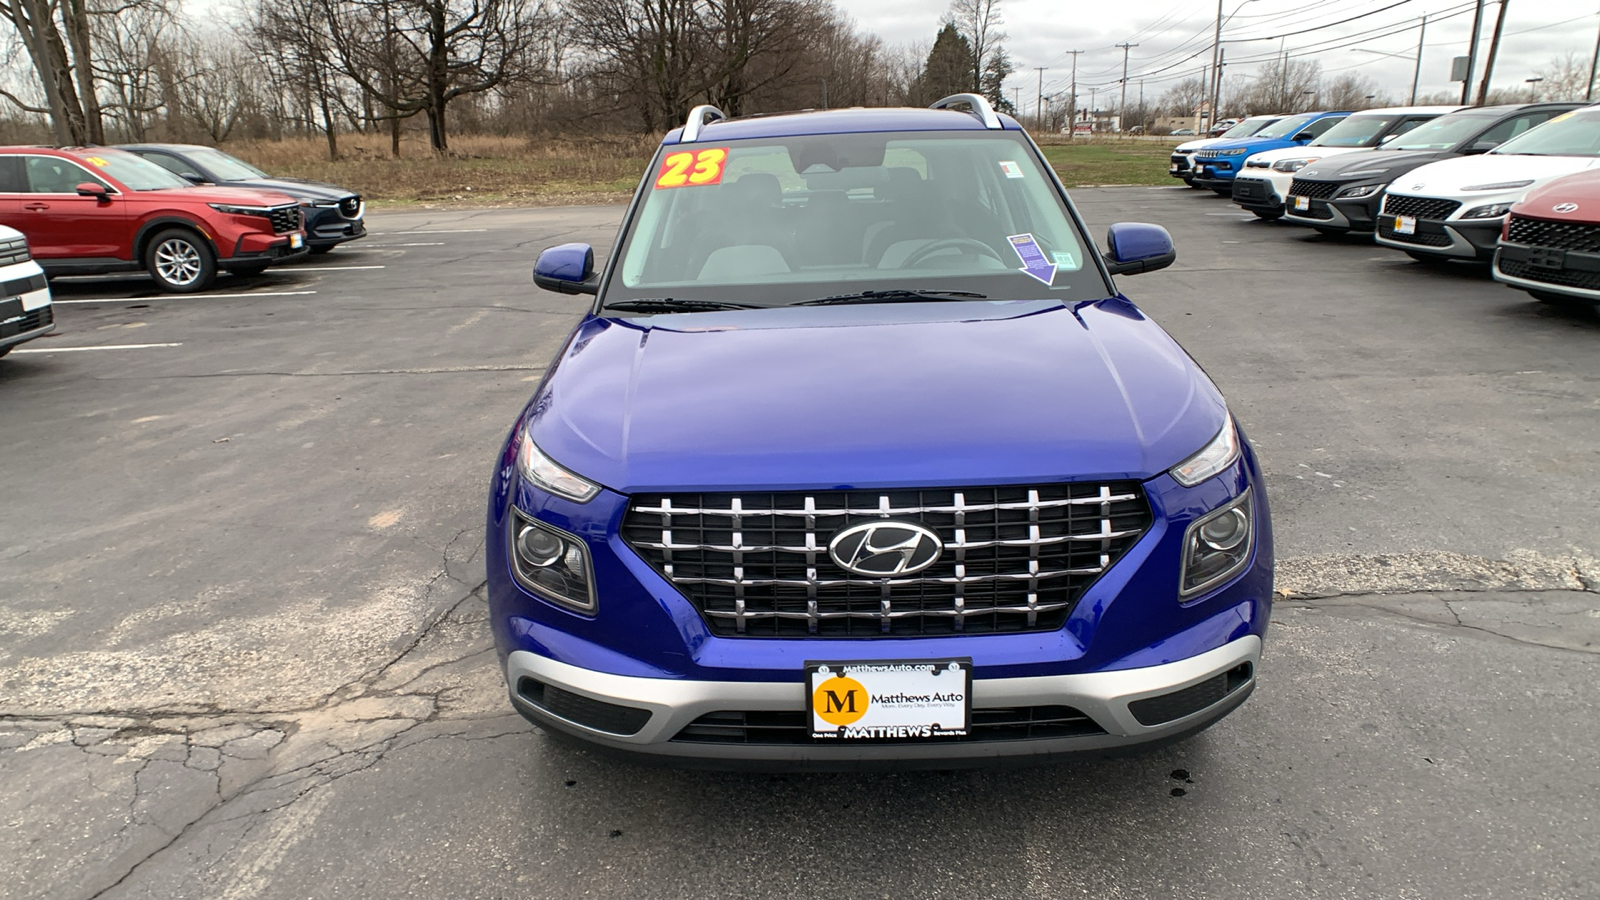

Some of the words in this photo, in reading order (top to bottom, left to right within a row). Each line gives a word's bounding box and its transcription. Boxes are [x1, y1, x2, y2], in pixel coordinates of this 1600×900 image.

[658, 149, 725, 187] 23
[842, 664, 936, 673] MatthewsAuto.com
[823, 689, 859, 714] M
[871, 692, 931, 704] Matthews
[931, 692, 964, 703] Auto
[844, 725, 931, 739] MATTHEWS
